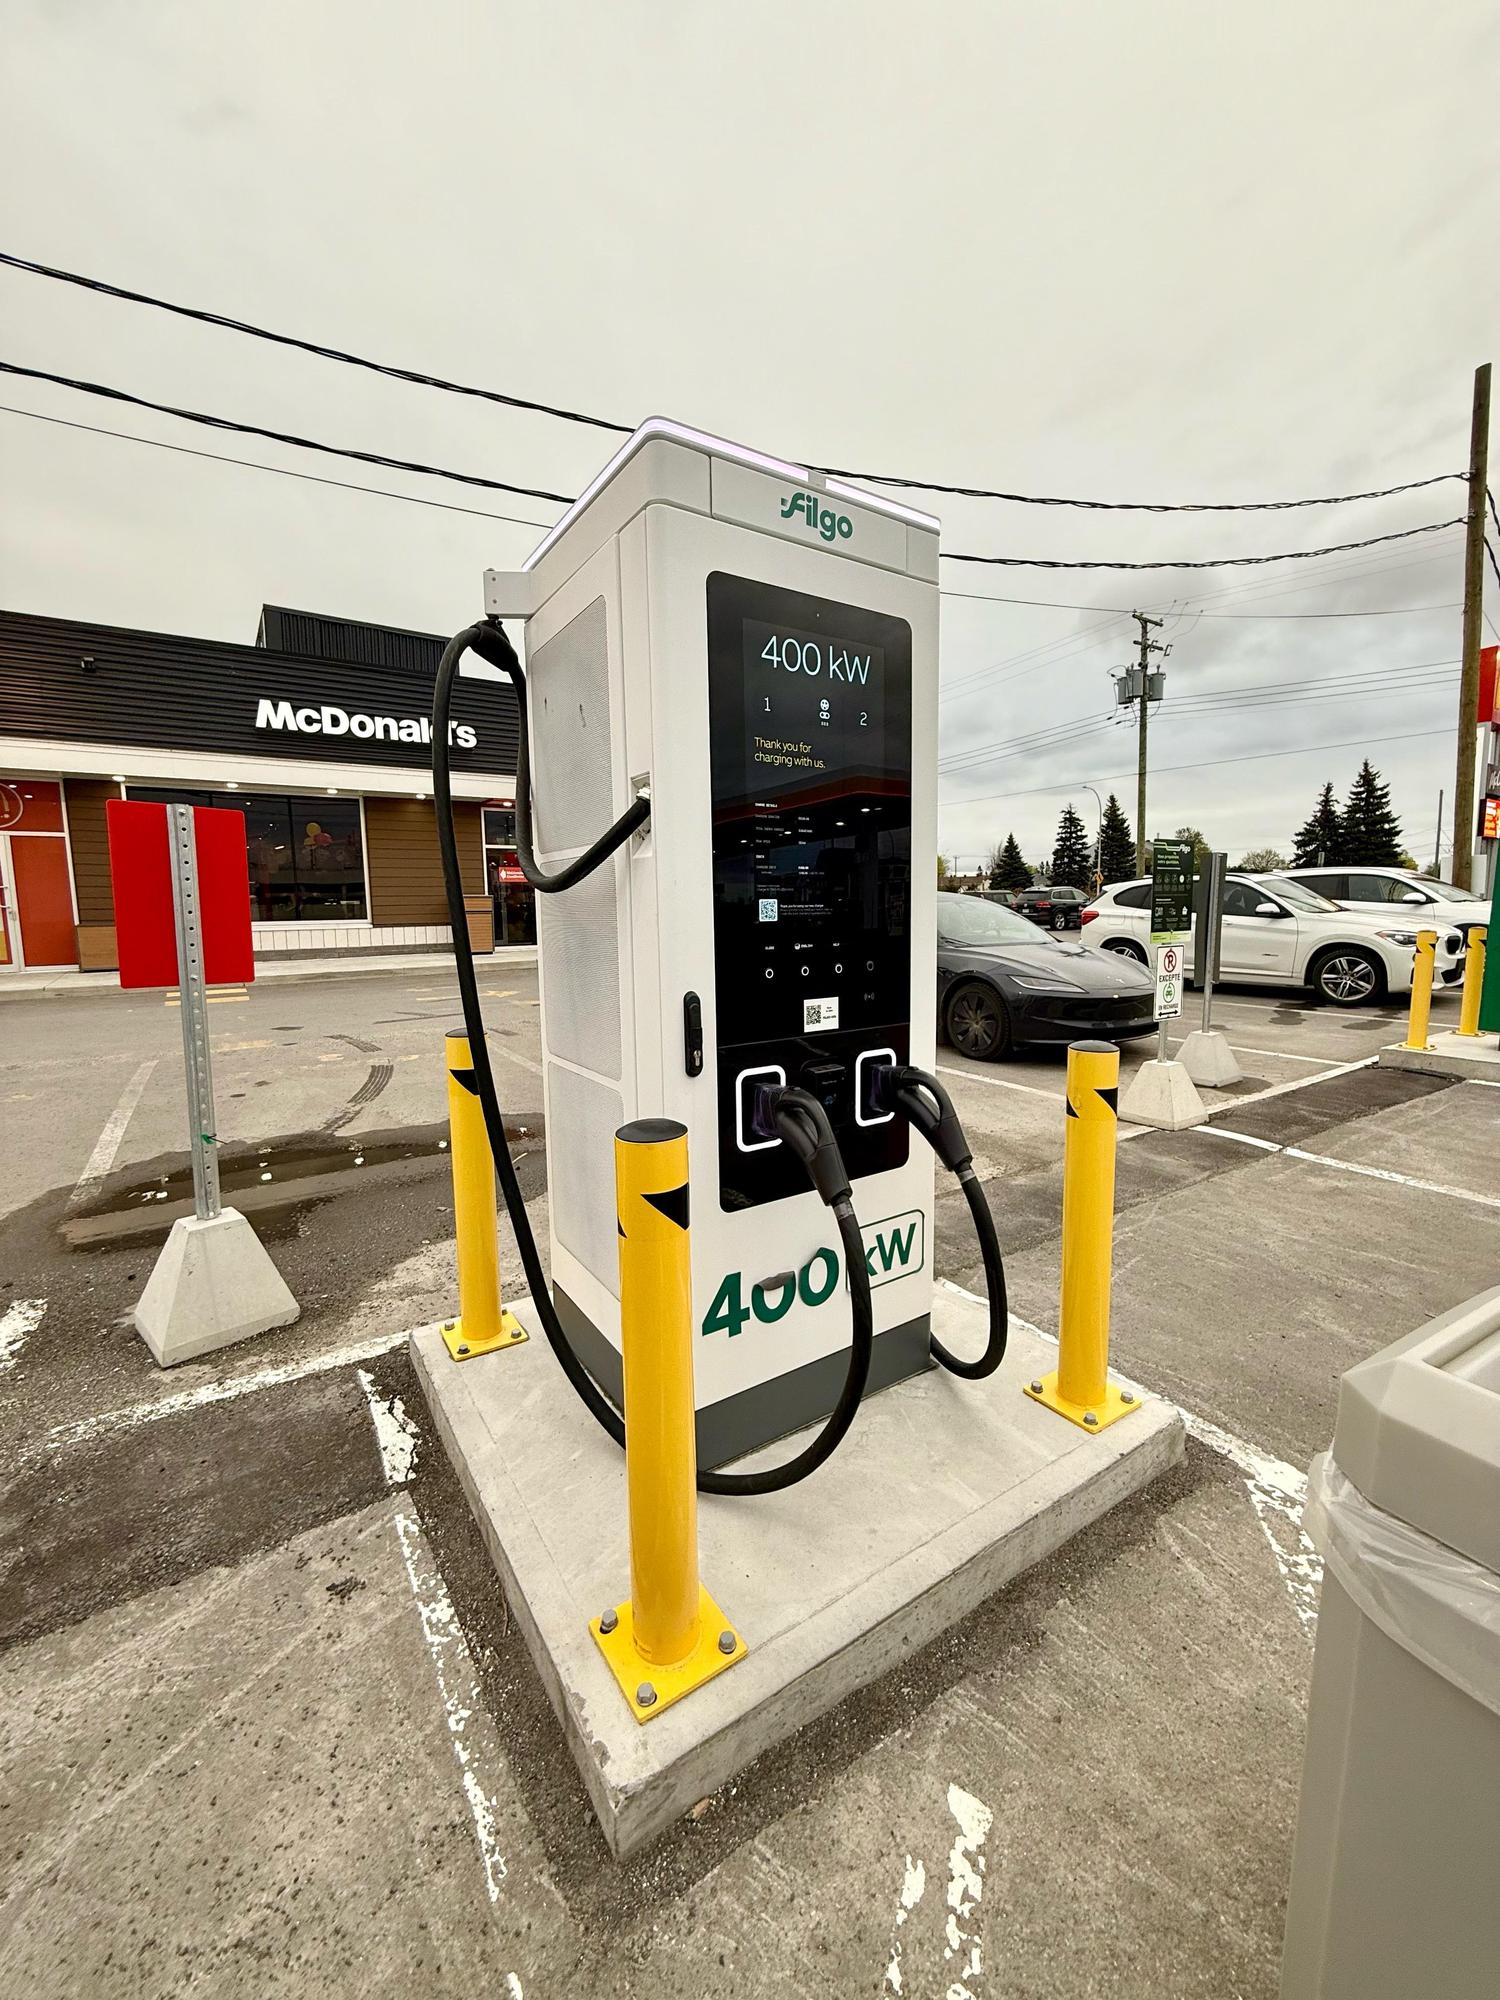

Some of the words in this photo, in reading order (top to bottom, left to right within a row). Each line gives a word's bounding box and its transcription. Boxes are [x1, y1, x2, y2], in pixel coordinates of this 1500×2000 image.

[761, 635, 821, 676] 400
[829, 645, 871, 685] kW
[763, 697, 771, 712] 1
[859, 711, 868, 726] 2
[754, 736, 782, 750] Thank
[782, 742, 798, 753] you
[800, 741, 812, 753] for
[754, 751, 793, 768] charging
[793, 756, 813, 767] with
[813, 759, 826, 769] us.
[702, 1247, 840, 1338] 400
